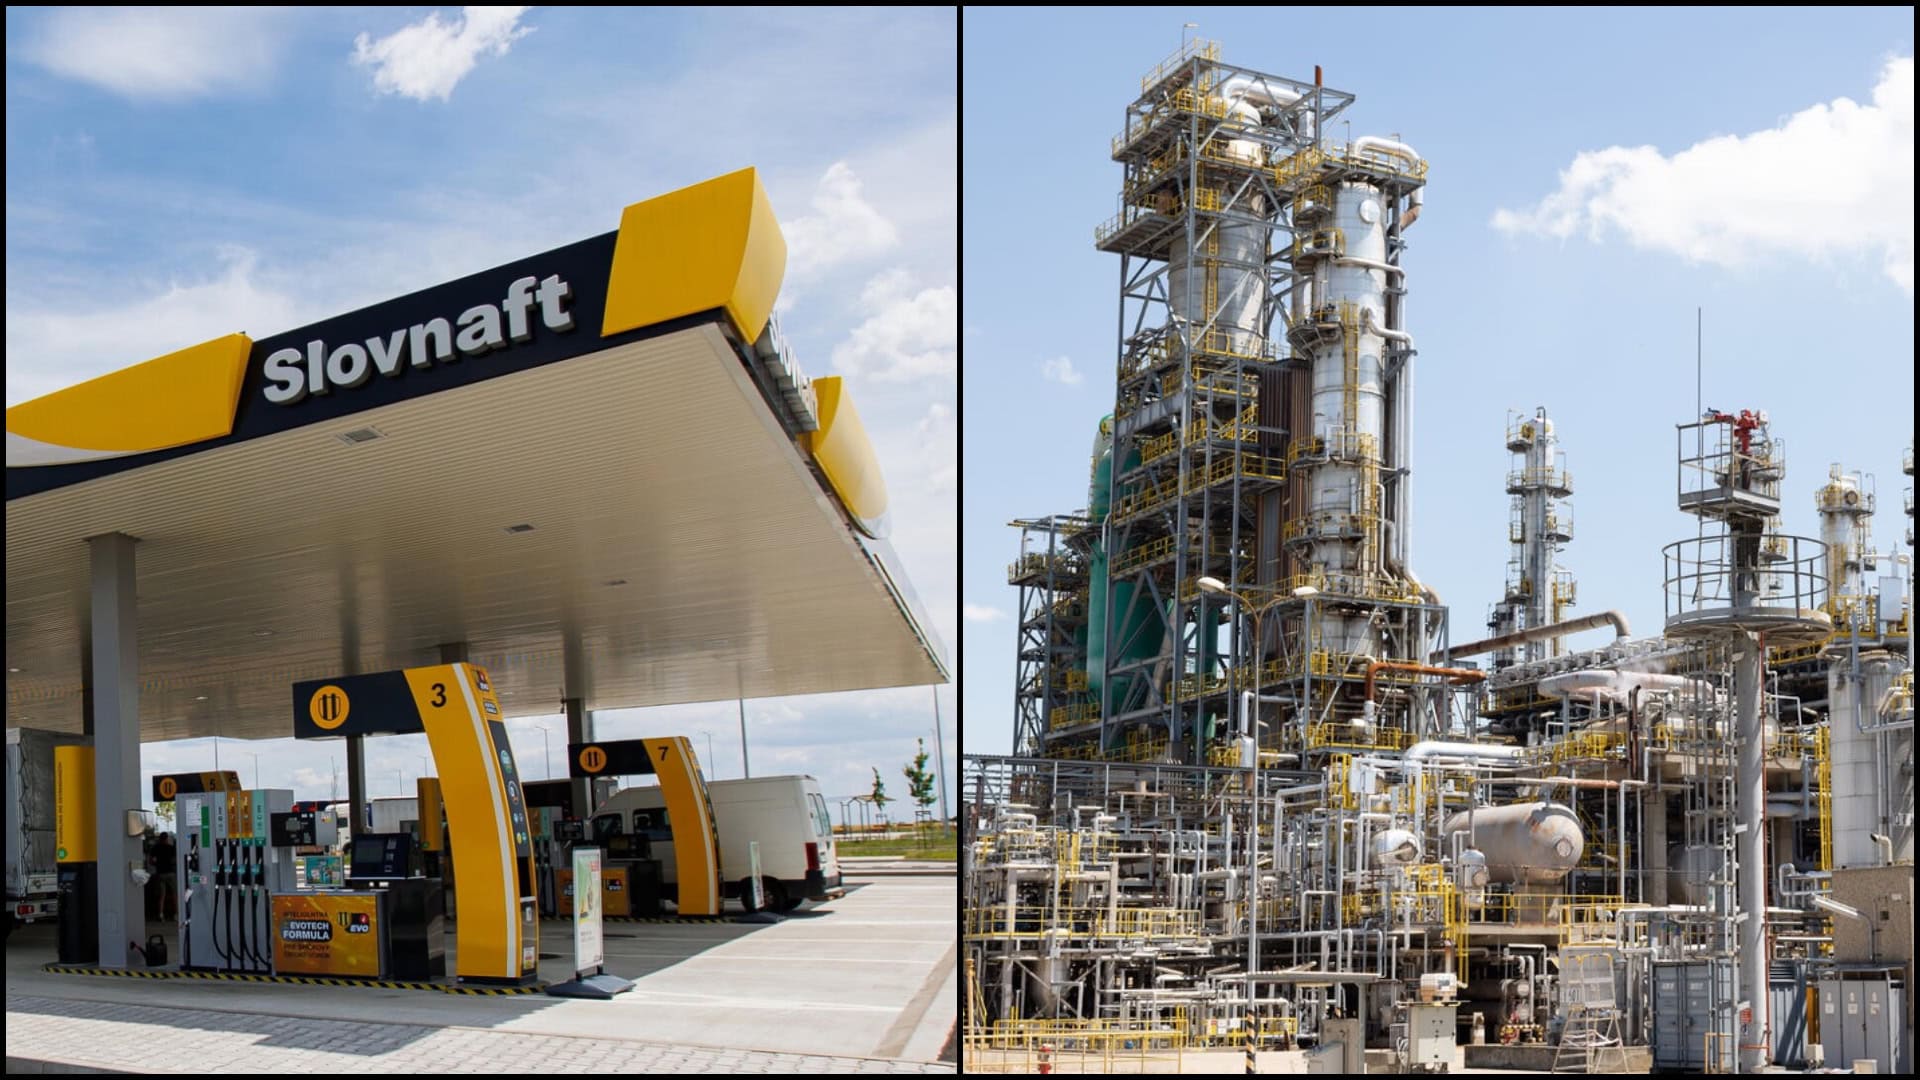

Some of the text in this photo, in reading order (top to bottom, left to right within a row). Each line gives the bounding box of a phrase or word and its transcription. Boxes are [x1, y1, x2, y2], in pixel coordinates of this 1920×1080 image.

[263, 273, 574, 404] Slovnaft
[431, 682, 447, 707] 3
[657, 745, 669, 761] 7
[290, 921, 329, 930] EVOTECH
[283, 930, 330, 940] FORMULA
